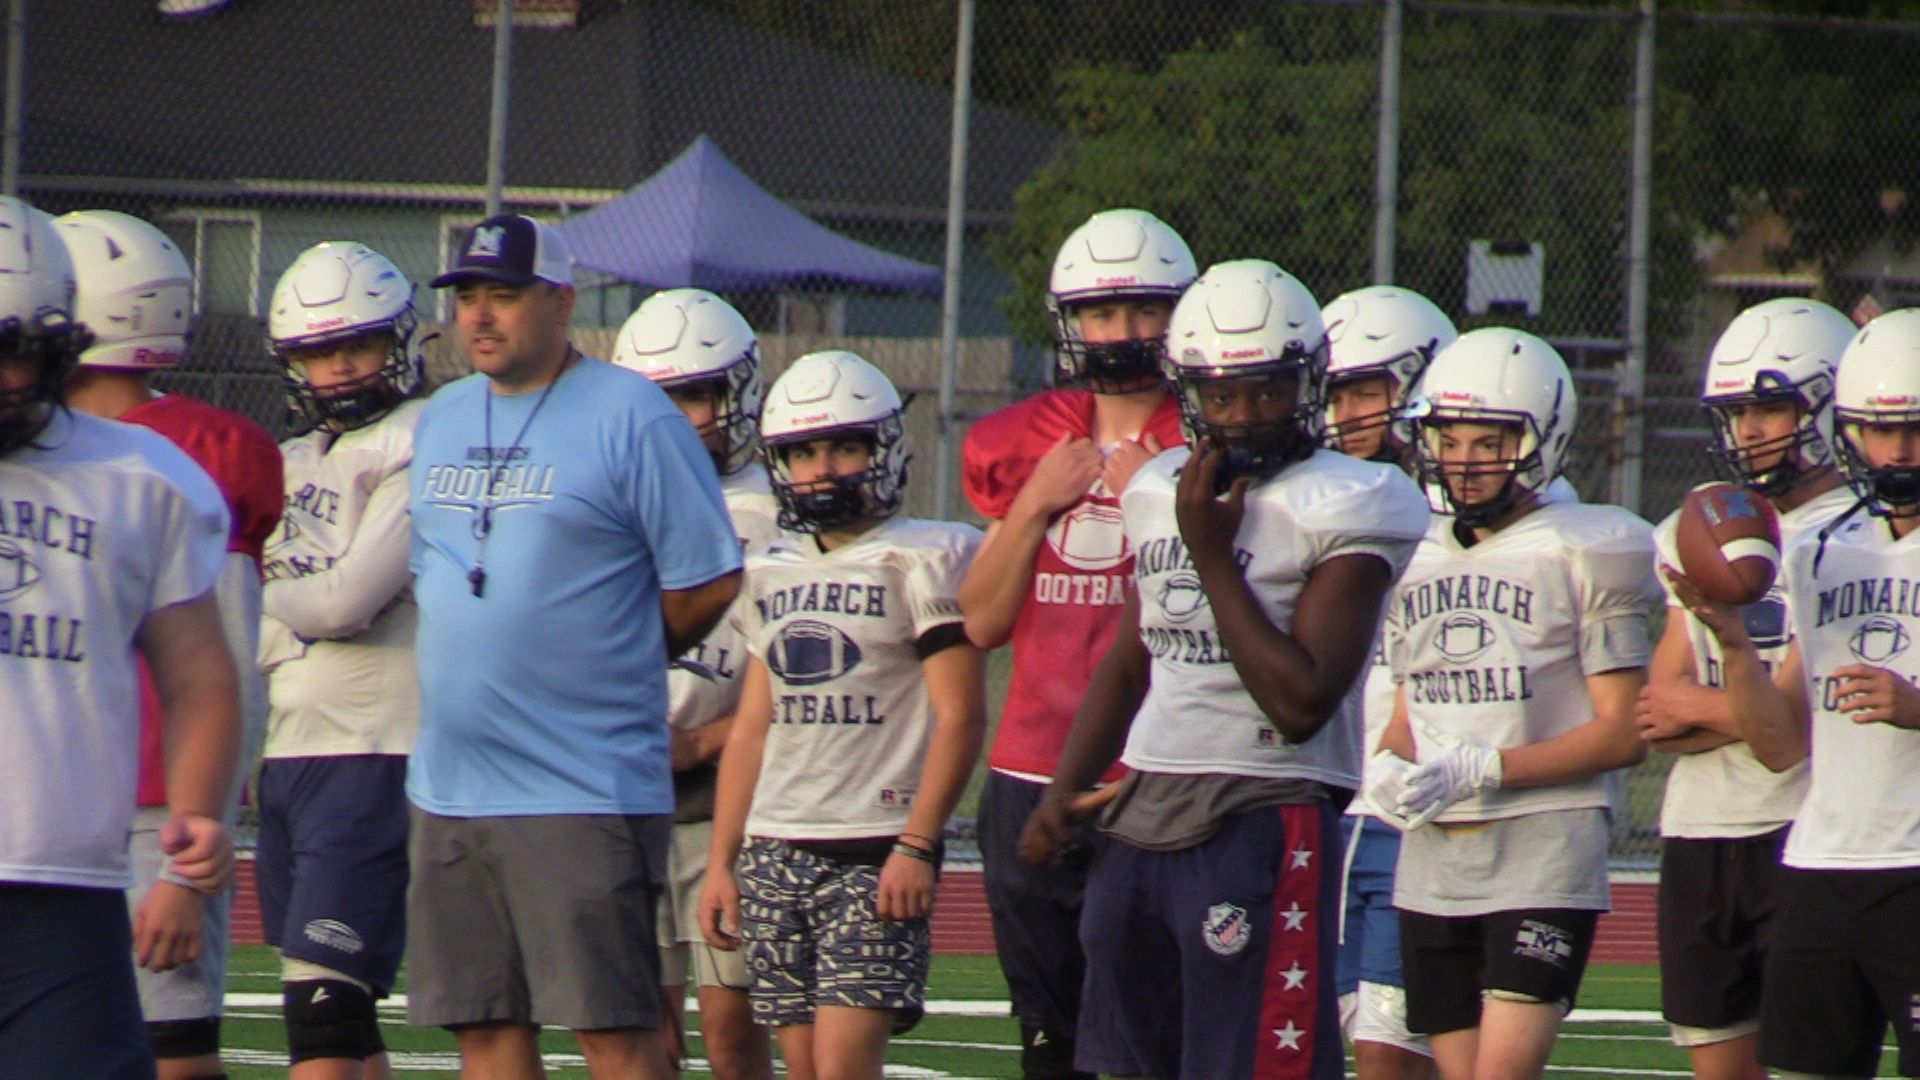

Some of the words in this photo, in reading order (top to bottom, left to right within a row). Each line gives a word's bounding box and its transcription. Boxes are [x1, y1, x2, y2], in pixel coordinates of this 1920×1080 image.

[420, 464, 554, 500] FOOTBALL
[1401, 575, 1534, 631] MONARCH
[1409, 665, 1534, 704] FOOTBALL
[772, 694, 886, 725] TBALL
